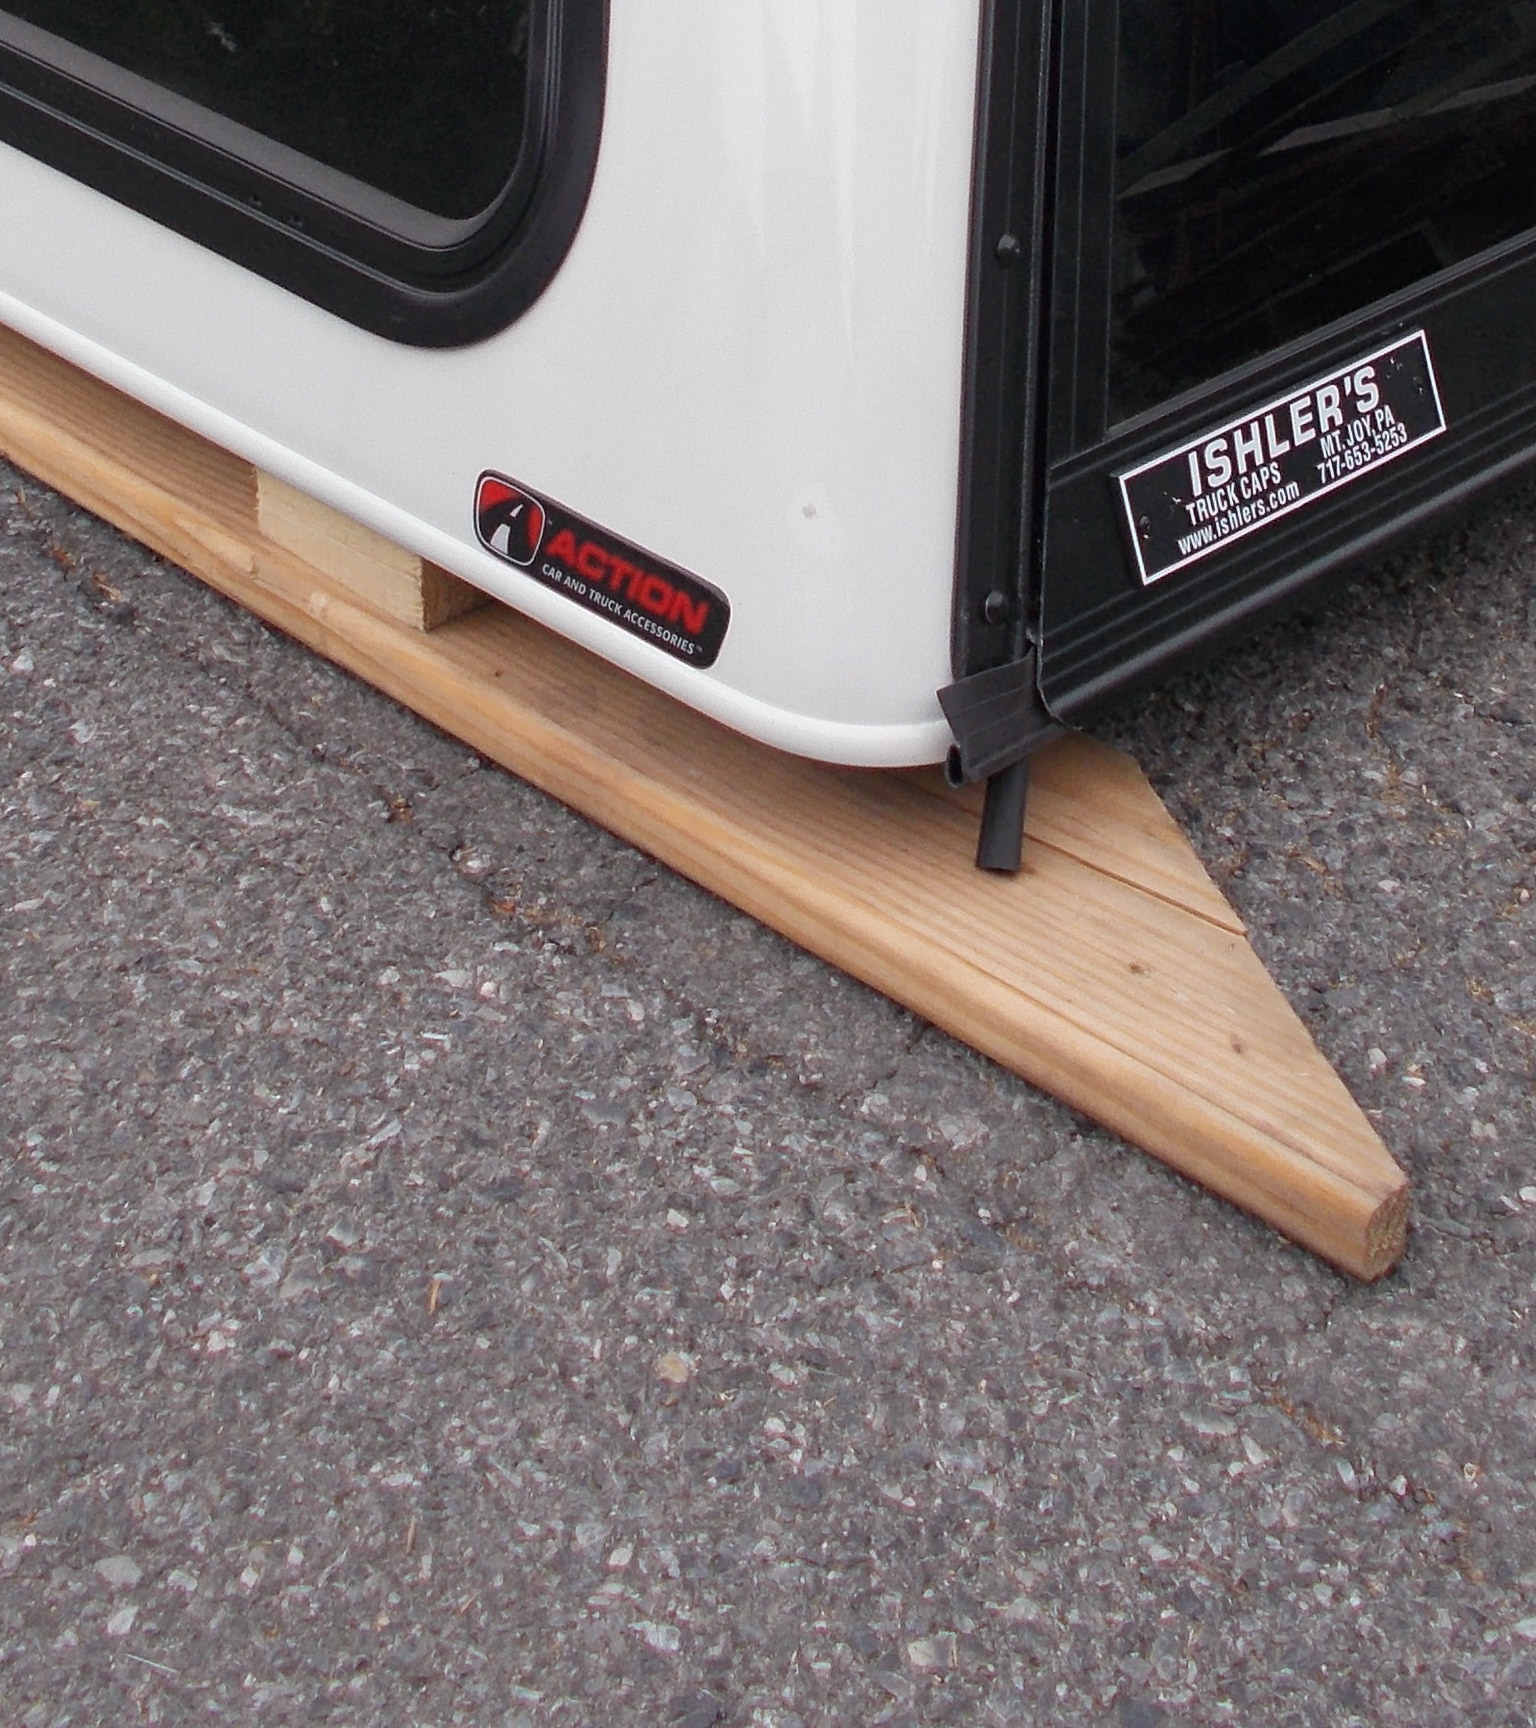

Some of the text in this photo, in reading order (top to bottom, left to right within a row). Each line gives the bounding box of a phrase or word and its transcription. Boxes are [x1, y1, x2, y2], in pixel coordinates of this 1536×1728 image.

[1186, 364, 1381, 497] ISHLER'S
[1375, 404, 1395, 433] PA
[1315, 423, 1409, 484] 717-653-5253
[1177, 481, 1300, 556] www.ishlers.com
[1185, 462, 1282, 527] TRUCK CAPS
[541, 562, 562, 583] CAR
[563, 575, 586, 596] AND
[588, 587, 622, 615] TRUCK
[545, 527, 710, 636] ACTION
